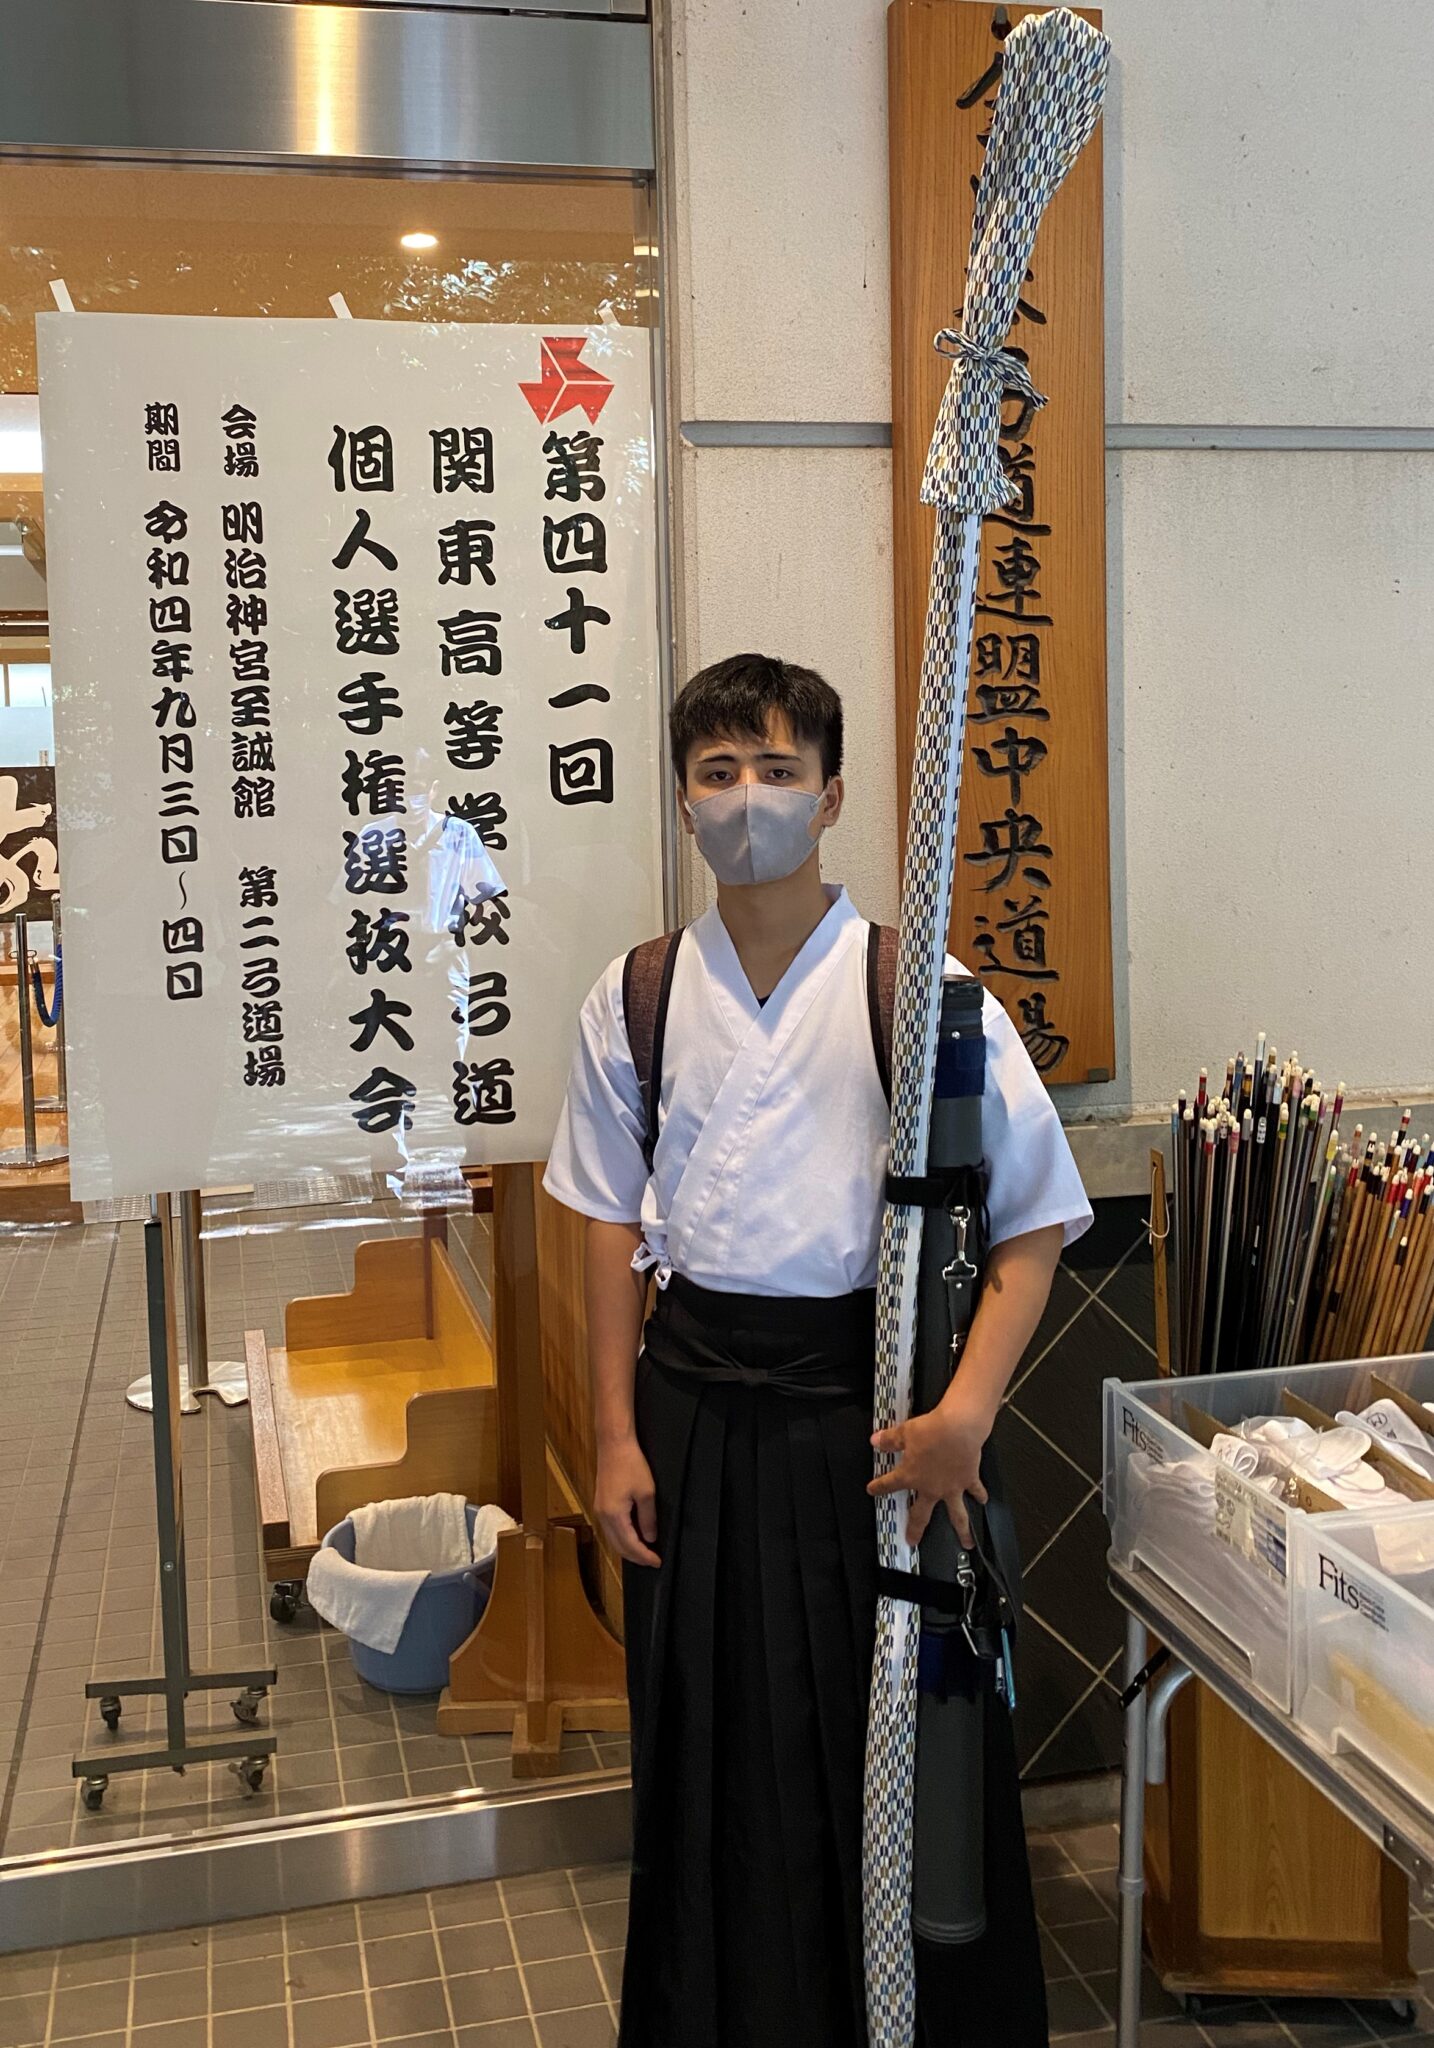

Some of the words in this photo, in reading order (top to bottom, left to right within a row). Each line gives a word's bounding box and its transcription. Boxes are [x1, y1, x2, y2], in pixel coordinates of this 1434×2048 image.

[143, 401, 182, 473] 期間
[220, 403, 260, 478] 会場
[221, 501, 276, 819] 明治神宮至誠館
[542, 430, 614, 806] 第四十一回
[327, 424, 417, 1134] 個人選手権選抜大会
[239, 865, 286, 1088] 第二弓道場
[1122, 1406, 1147, 1451] Fits
[1318, 1552, 1360, 1610] Fits
